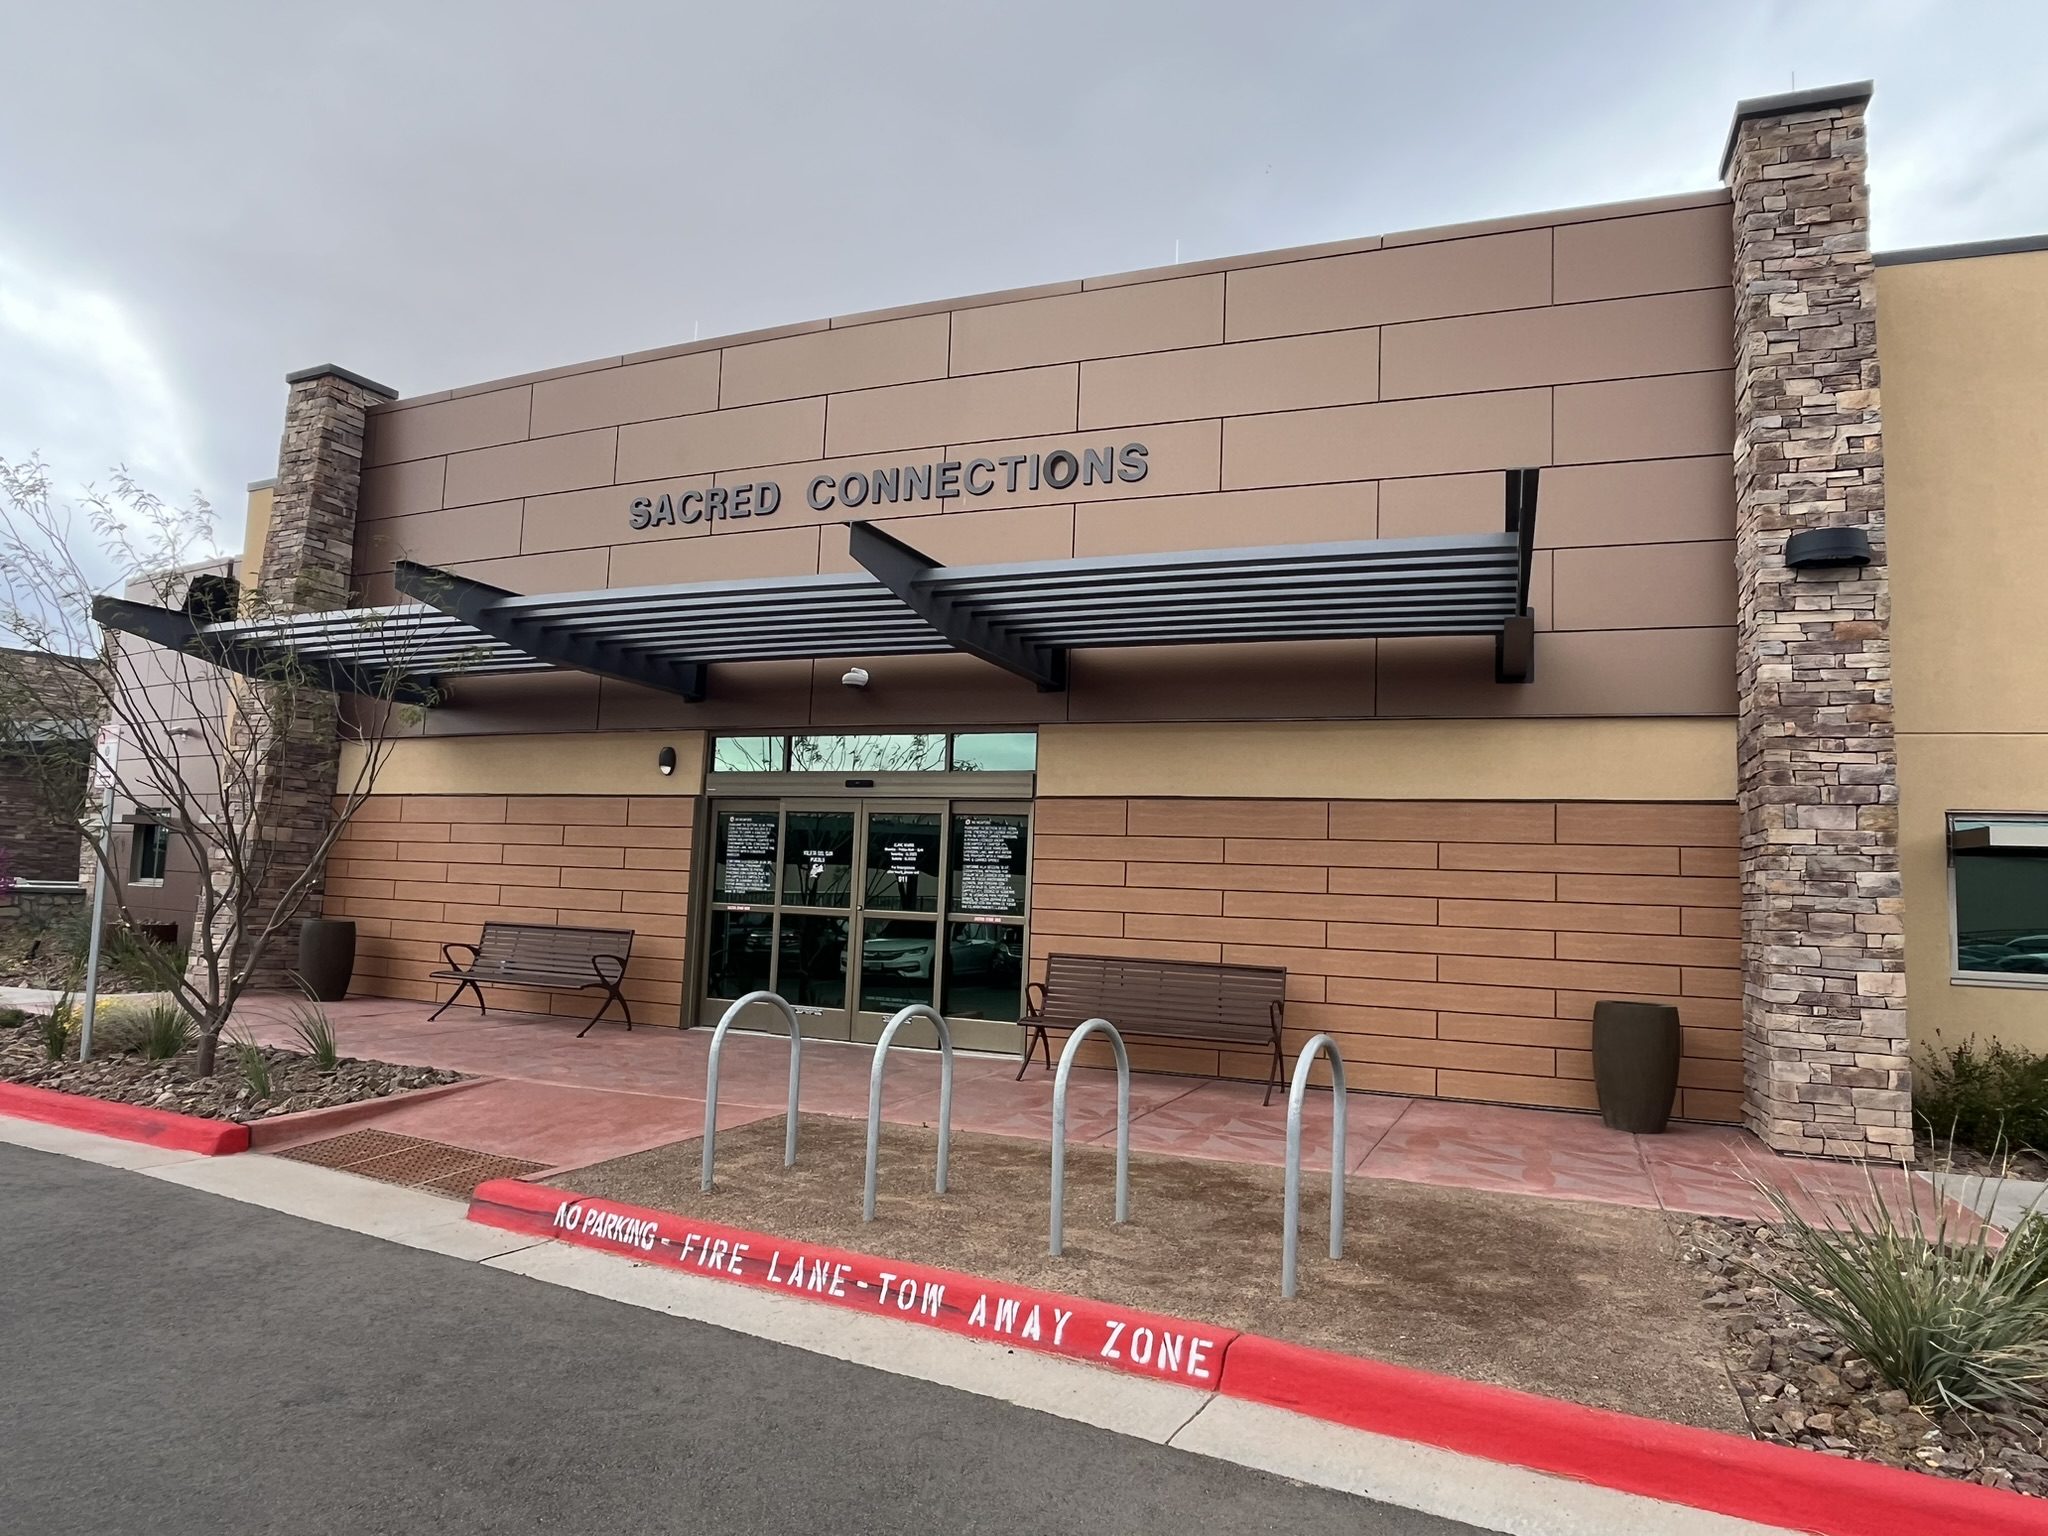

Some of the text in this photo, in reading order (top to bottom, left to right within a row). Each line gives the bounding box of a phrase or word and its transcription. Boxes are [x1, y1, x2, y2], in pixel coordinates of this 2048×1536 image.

[629, 442, 1149, 530] SACRED CONNECTIONS
[553, 1201, 582, 1230] NO
[581, 1208, 659, 1251] PARKING
[679, 1233, 750, 1275] FIRE
[766, 1251, 852, 1297] LANE
[878, 1273, 946, 1318] TOW
[967, 1294, 1073, 1345] AWAY
[1101, 1320, 1214, 1378] ZONE
